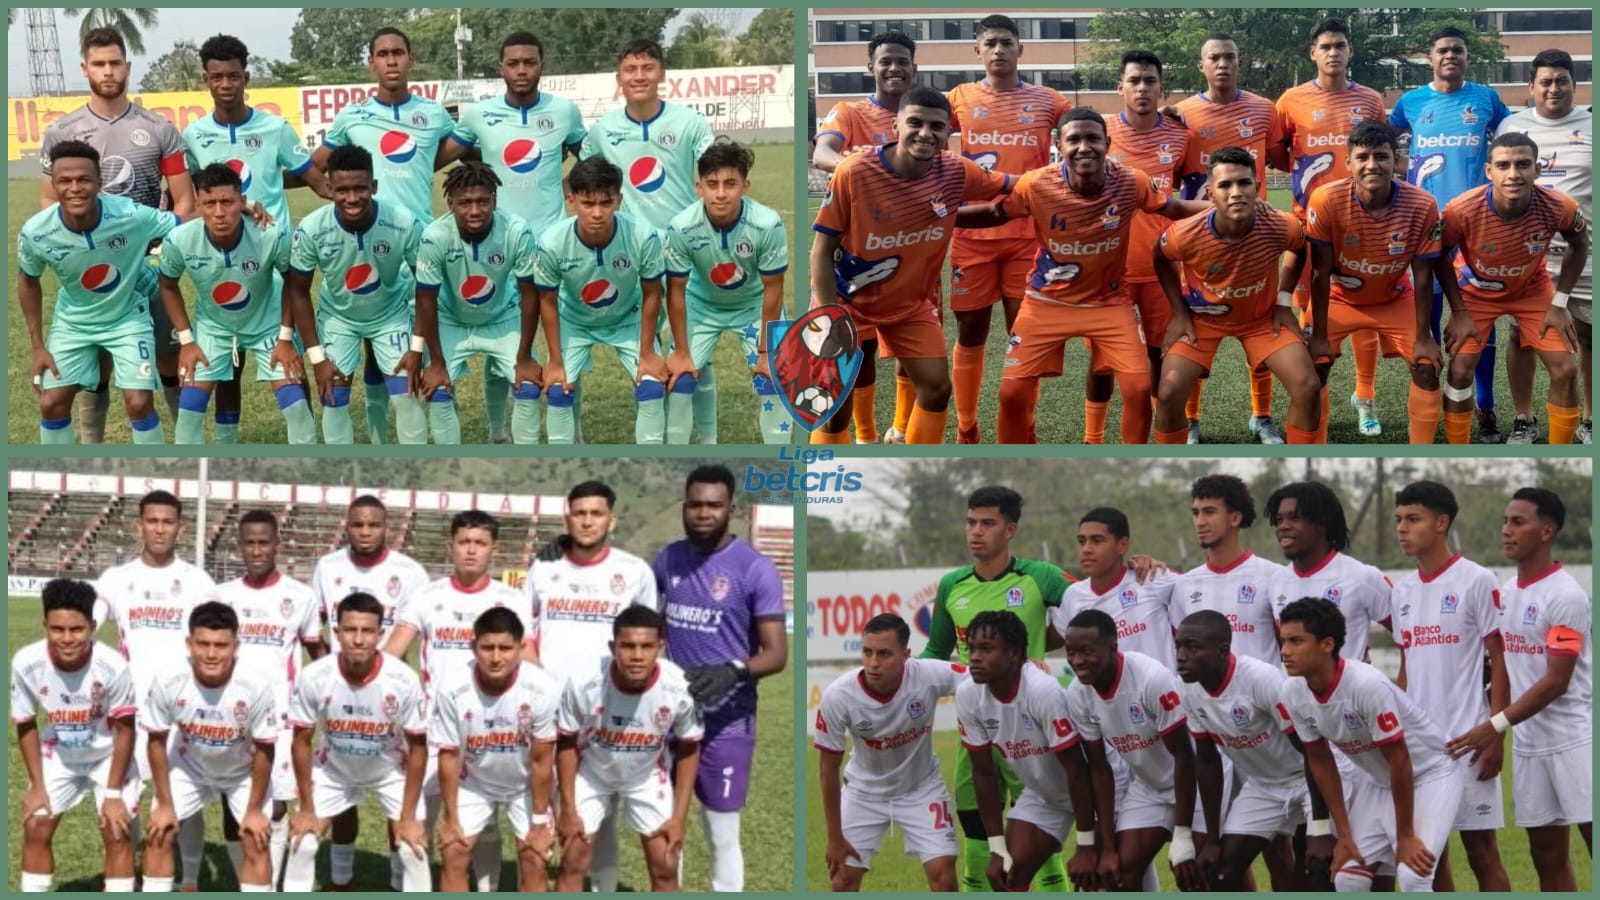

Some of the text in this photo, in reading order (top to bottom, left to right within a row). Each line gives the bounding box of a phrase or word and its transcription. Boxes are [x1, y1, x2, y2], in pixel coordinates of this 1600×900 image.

[967, 130, 1038, 146] betcris
[1417, 133, 1481, 148] betcris
[865, 225, 944, 250] betcris
[1048, 237, 1120, 255] betcris
[137, 341, 149, 360] 6
[1413, 624, 1441, 636] Banco
[928, 800, 954, 830] 24
